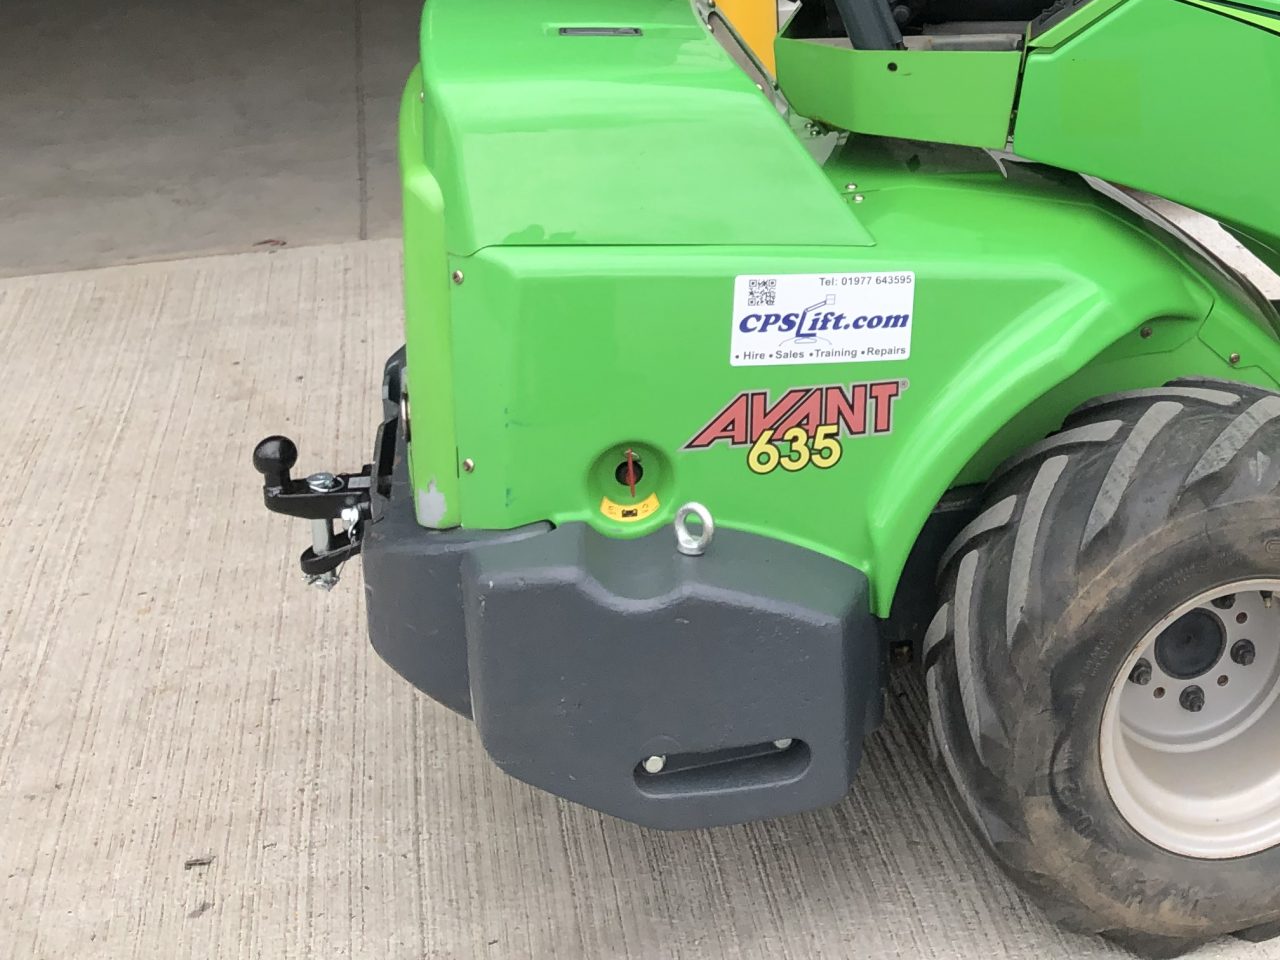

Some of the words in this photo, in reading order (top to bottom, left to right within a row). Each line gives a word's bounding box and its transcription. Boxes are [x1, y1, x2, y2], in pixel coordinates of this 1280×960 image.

[819, 277, 838, 287] Tel:
[841, 276, 873, 286] 01977
[875, 274, 912, 285] 643595
[738, 308, 910, 338] CPSLift.com
[743, 350, 766, 360] Hire
[775, 349, 805, 359] Sales
[814, 348, 858, 360] Training
[866, 346, 907, 357] Repairs
[746, 423, 843, 475] 635
